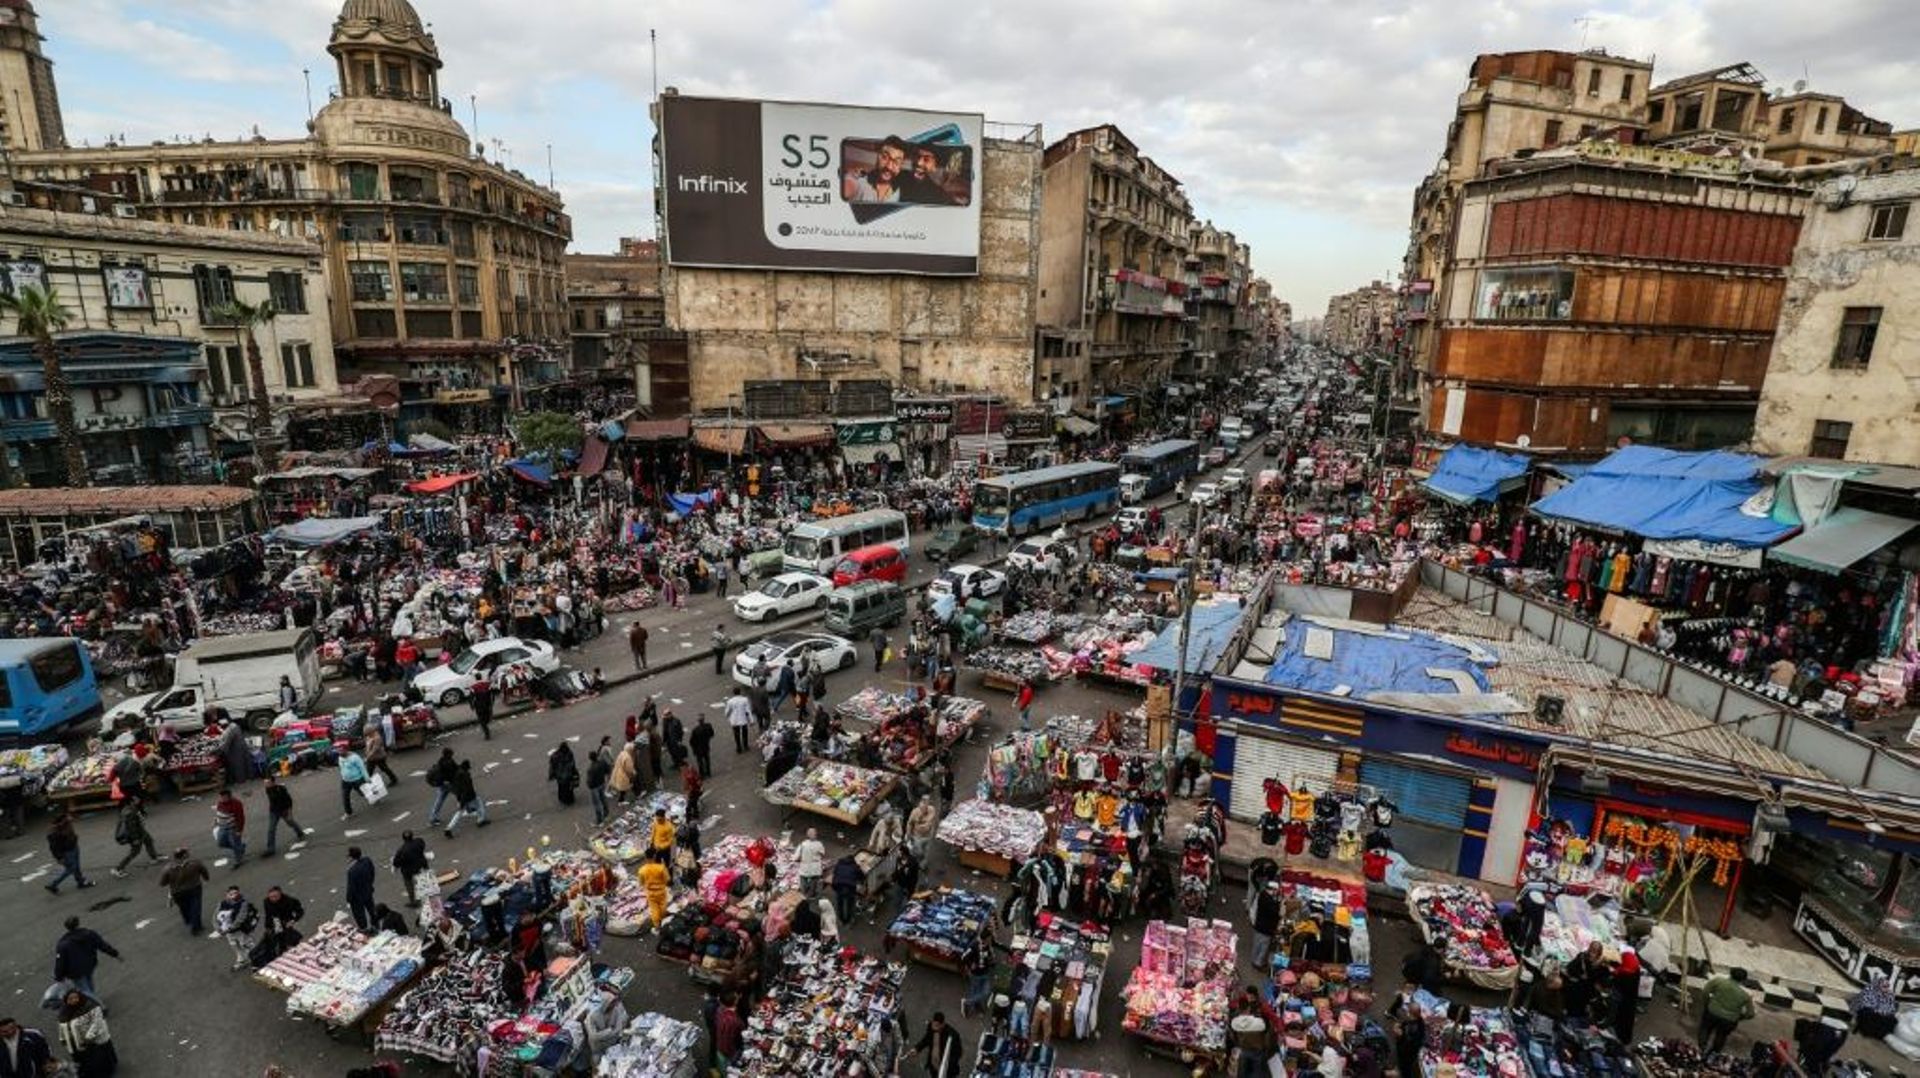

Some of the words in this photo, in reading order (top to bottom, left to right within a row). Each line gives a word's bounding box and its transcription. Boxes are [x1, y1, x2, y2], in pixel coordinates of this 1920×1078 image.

[781, 134, 831, 168] S5
[678, 174, 748, 193] Infinix
[768, 172, 831, 191] هتشوف
[788, 192, 831, 209] العجب
